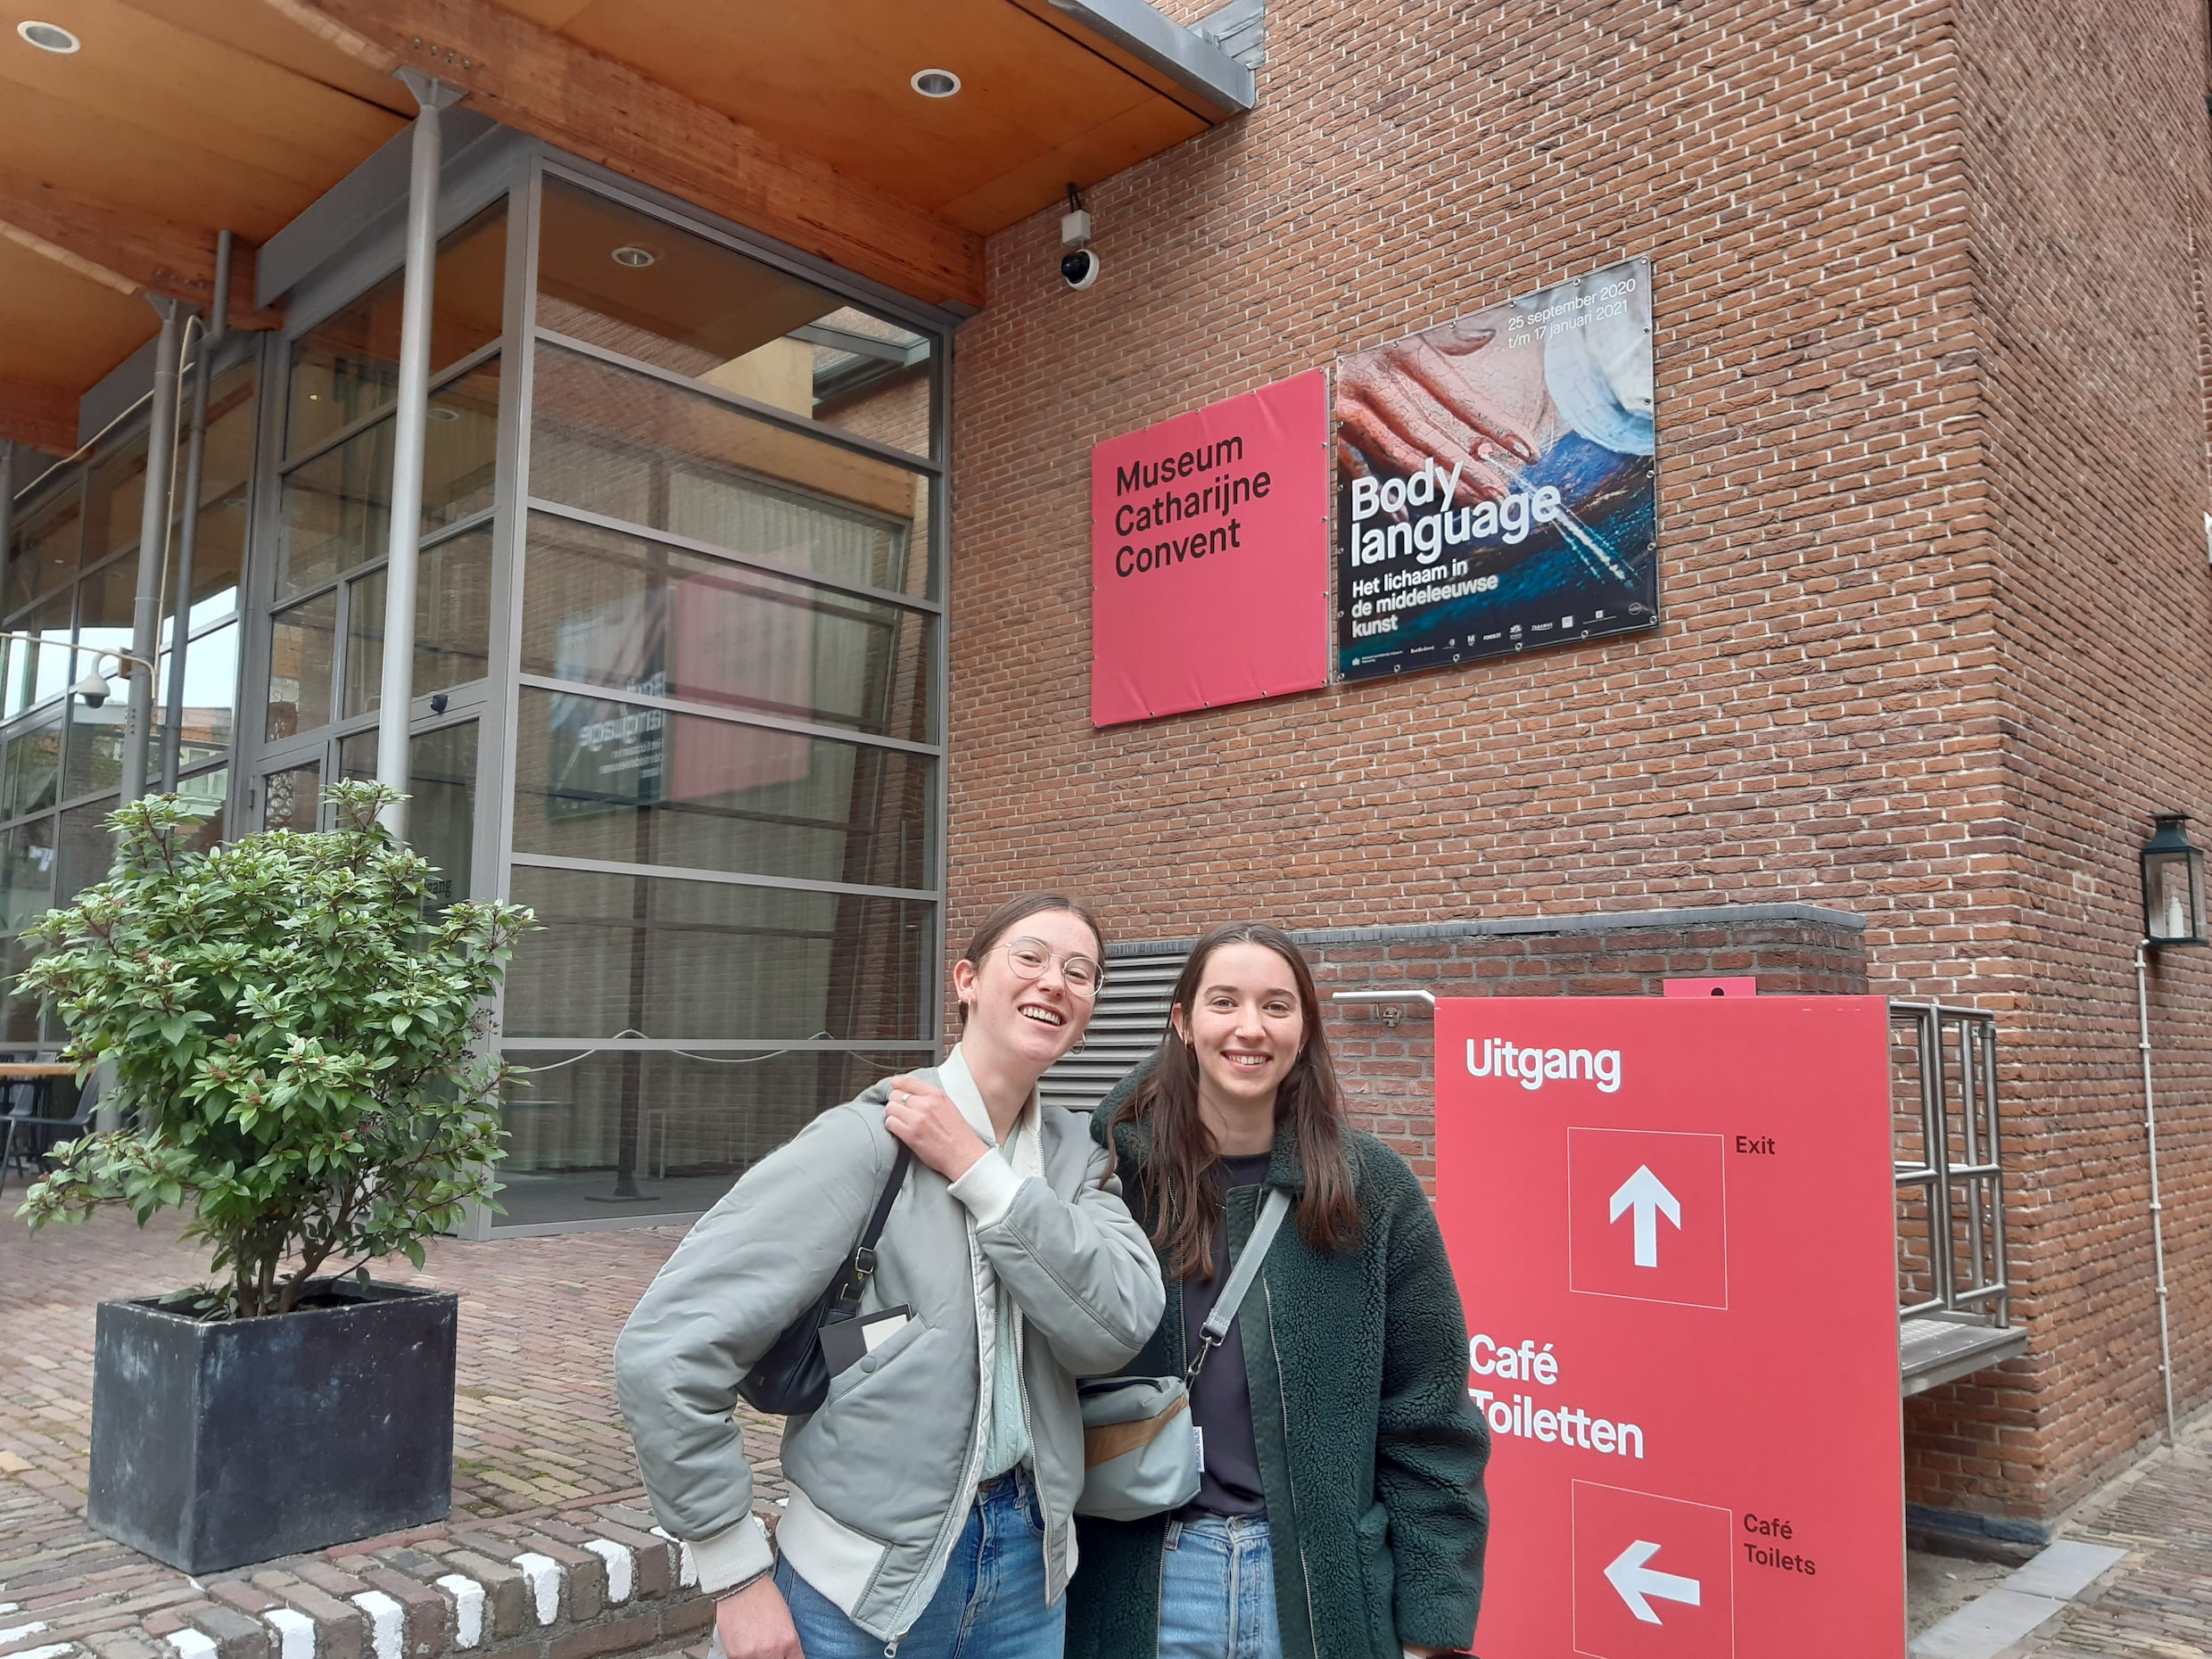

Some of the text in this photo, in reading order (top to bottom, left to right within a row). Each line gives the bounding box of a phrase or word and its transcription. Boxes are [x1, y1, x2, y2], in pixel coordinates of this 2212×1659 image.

[1507, 278, 1636, 331] 25 september 2020
[1507, 300, 1628, 349] t/m 17 januari 2021
[1117, 436, 1242, 496] Museum
[1351, 457, 1464, 522] Body
[1116, 472, 1271, 536] Catharijne
[1351, 484, 1561, 567] language
[1116, 518, 1241, 577] Convent
[1351, 574, 1498, 618] de middeleeuwse
[1352, 558, 1468, 598] Het lichaam in
[1352, 615, 1398, 639] kunst
[1466, 1038, 1621, 1093] Uitgang
[1736, 1135, 1776, 1155] Exit
[1470, 1334, 1558, 1384] Café
[1744, 1513, 1793, 1539] Café
[1744, 1542, 1816, 1575] Toilets
